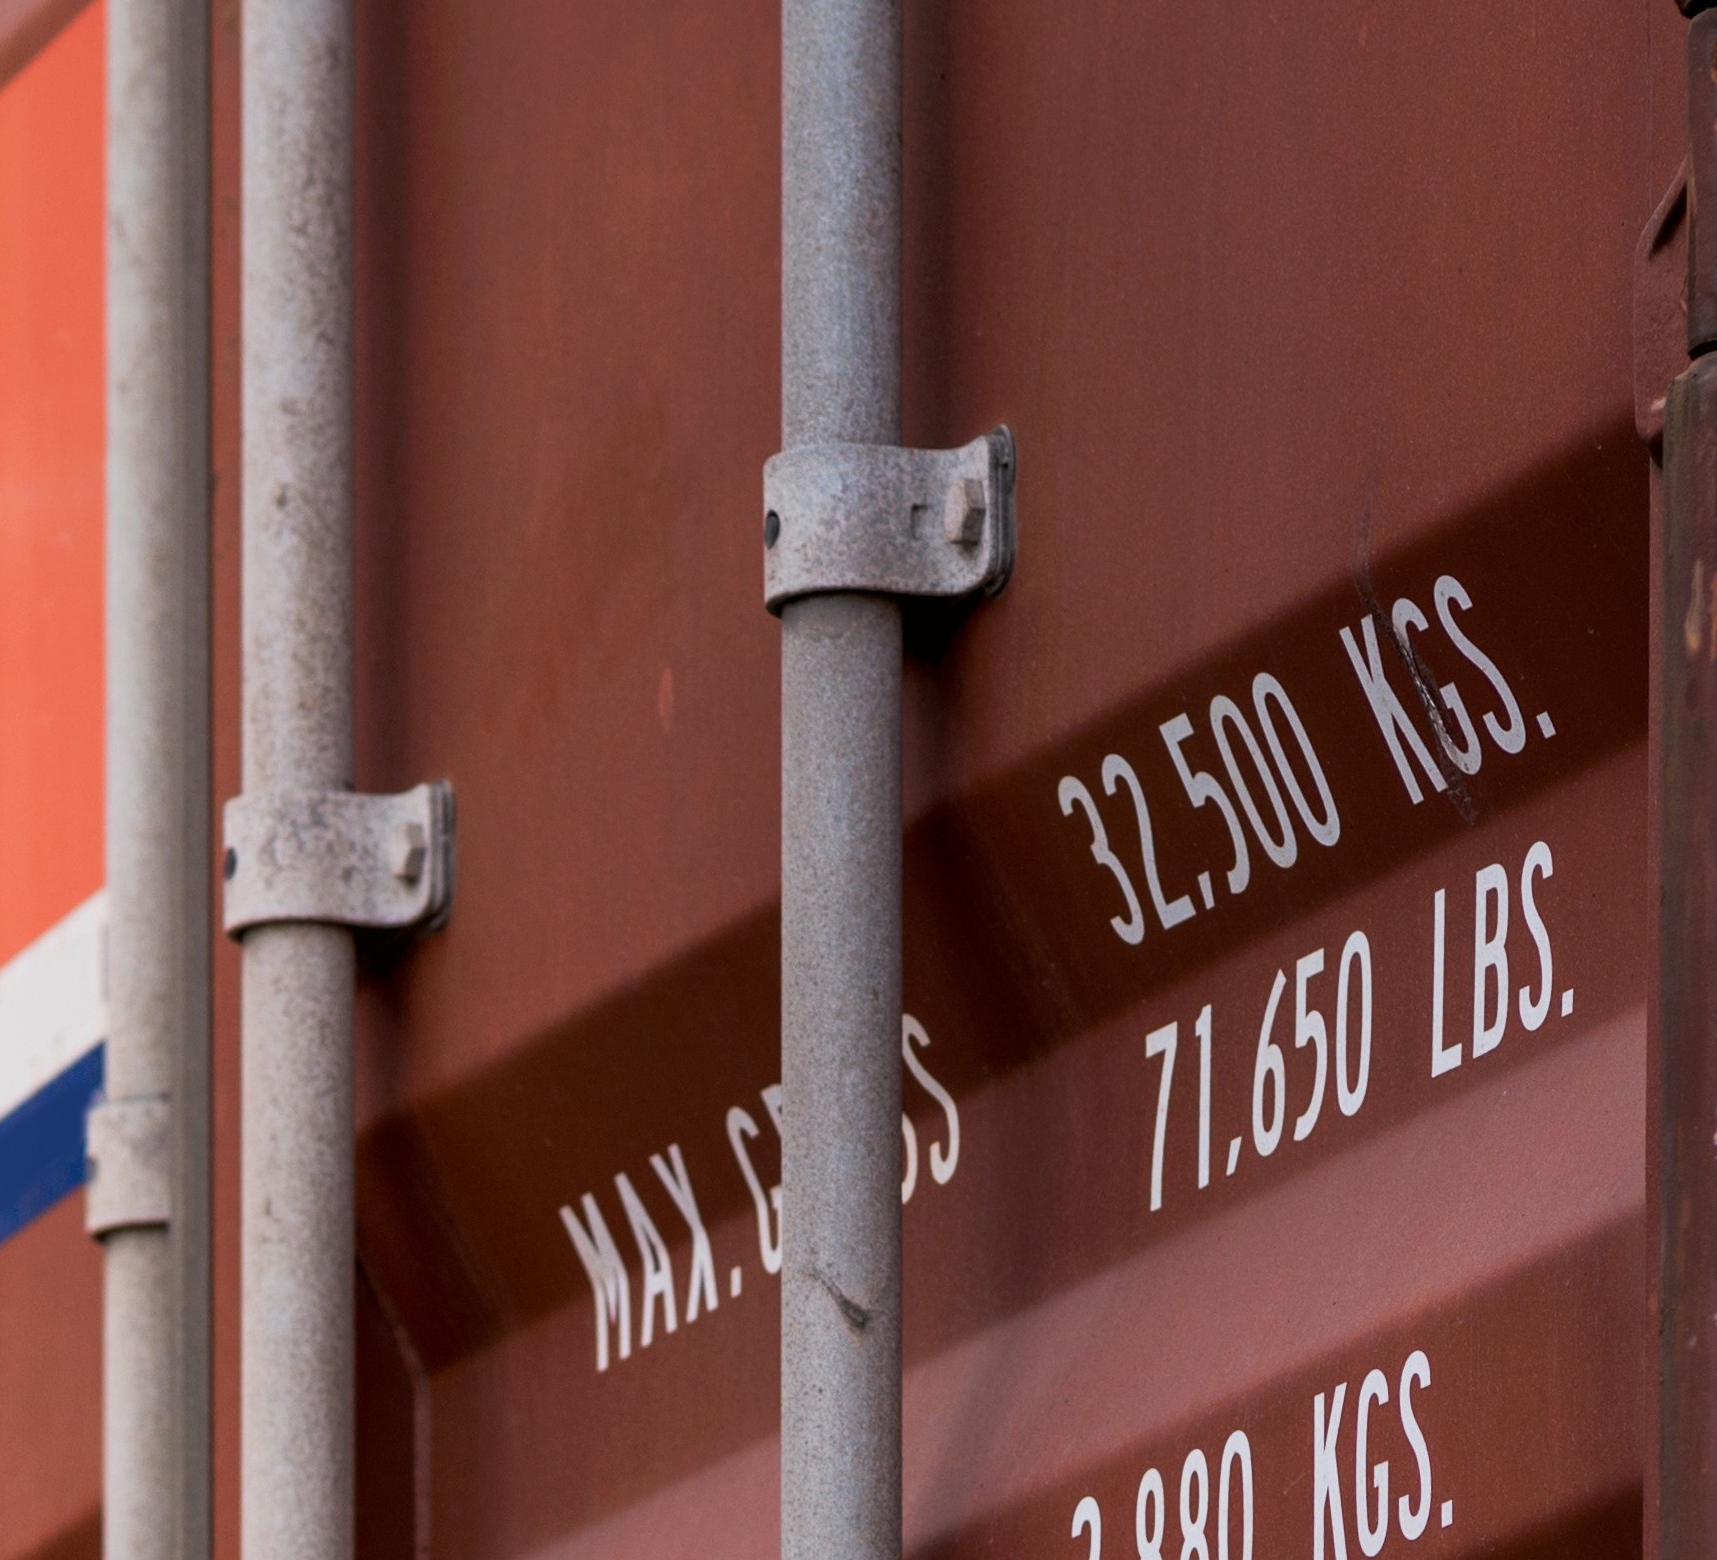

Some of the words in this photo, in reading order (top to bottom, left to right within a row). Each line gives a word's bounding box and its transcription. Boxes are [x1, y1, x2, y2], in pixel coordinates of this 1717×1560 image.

[1057, 671, 1343, 946] 32,500
[1339, 574, 1558, 806] KGS.
[1144, 930, 1373, 1213] 71,650
[1430, 841, 1576, 1079] LBS.
